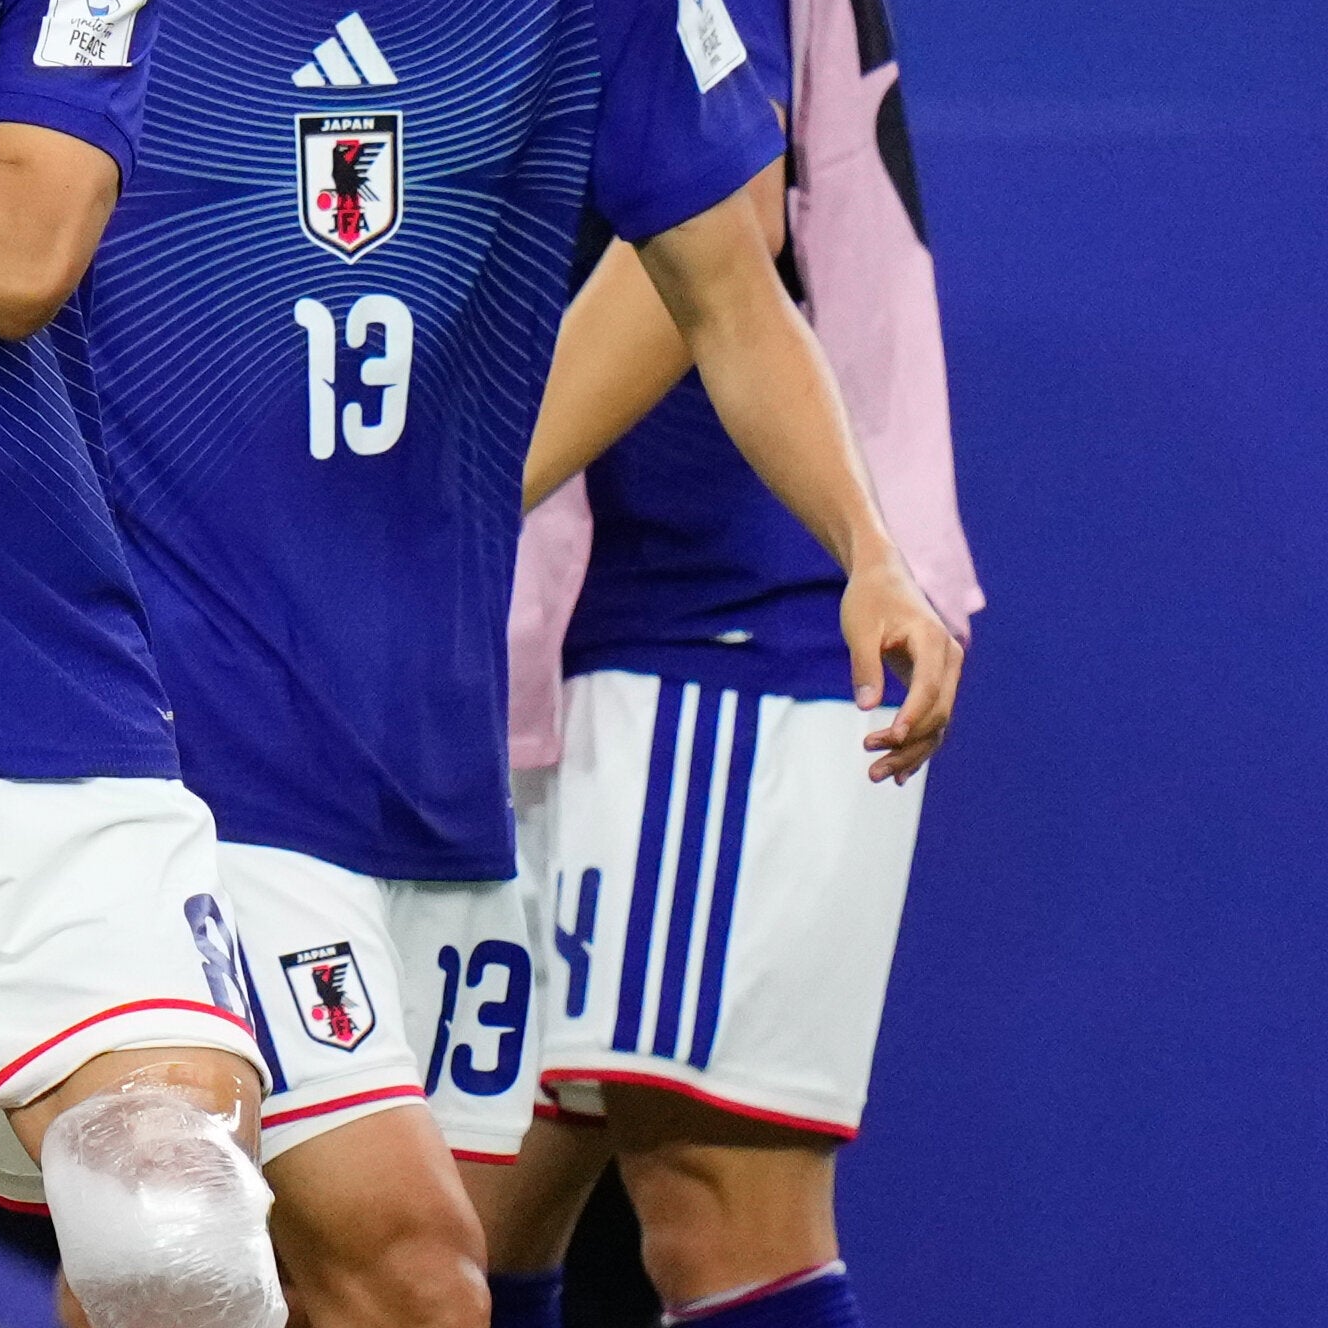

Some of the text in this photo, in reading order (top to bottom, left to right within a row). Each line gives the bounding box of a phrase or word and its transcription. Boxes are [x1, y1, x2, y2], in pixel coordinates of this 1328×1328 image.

[69, 30, 108, 60] PEACE
[321, 118, 376, 132] JAPAN
[328, 212, 371, 234] JFA
[293, 293, 415, 460] 13
[296, 946, 336, 963] JAPAN
[425, 939, 532, 1097] 13
